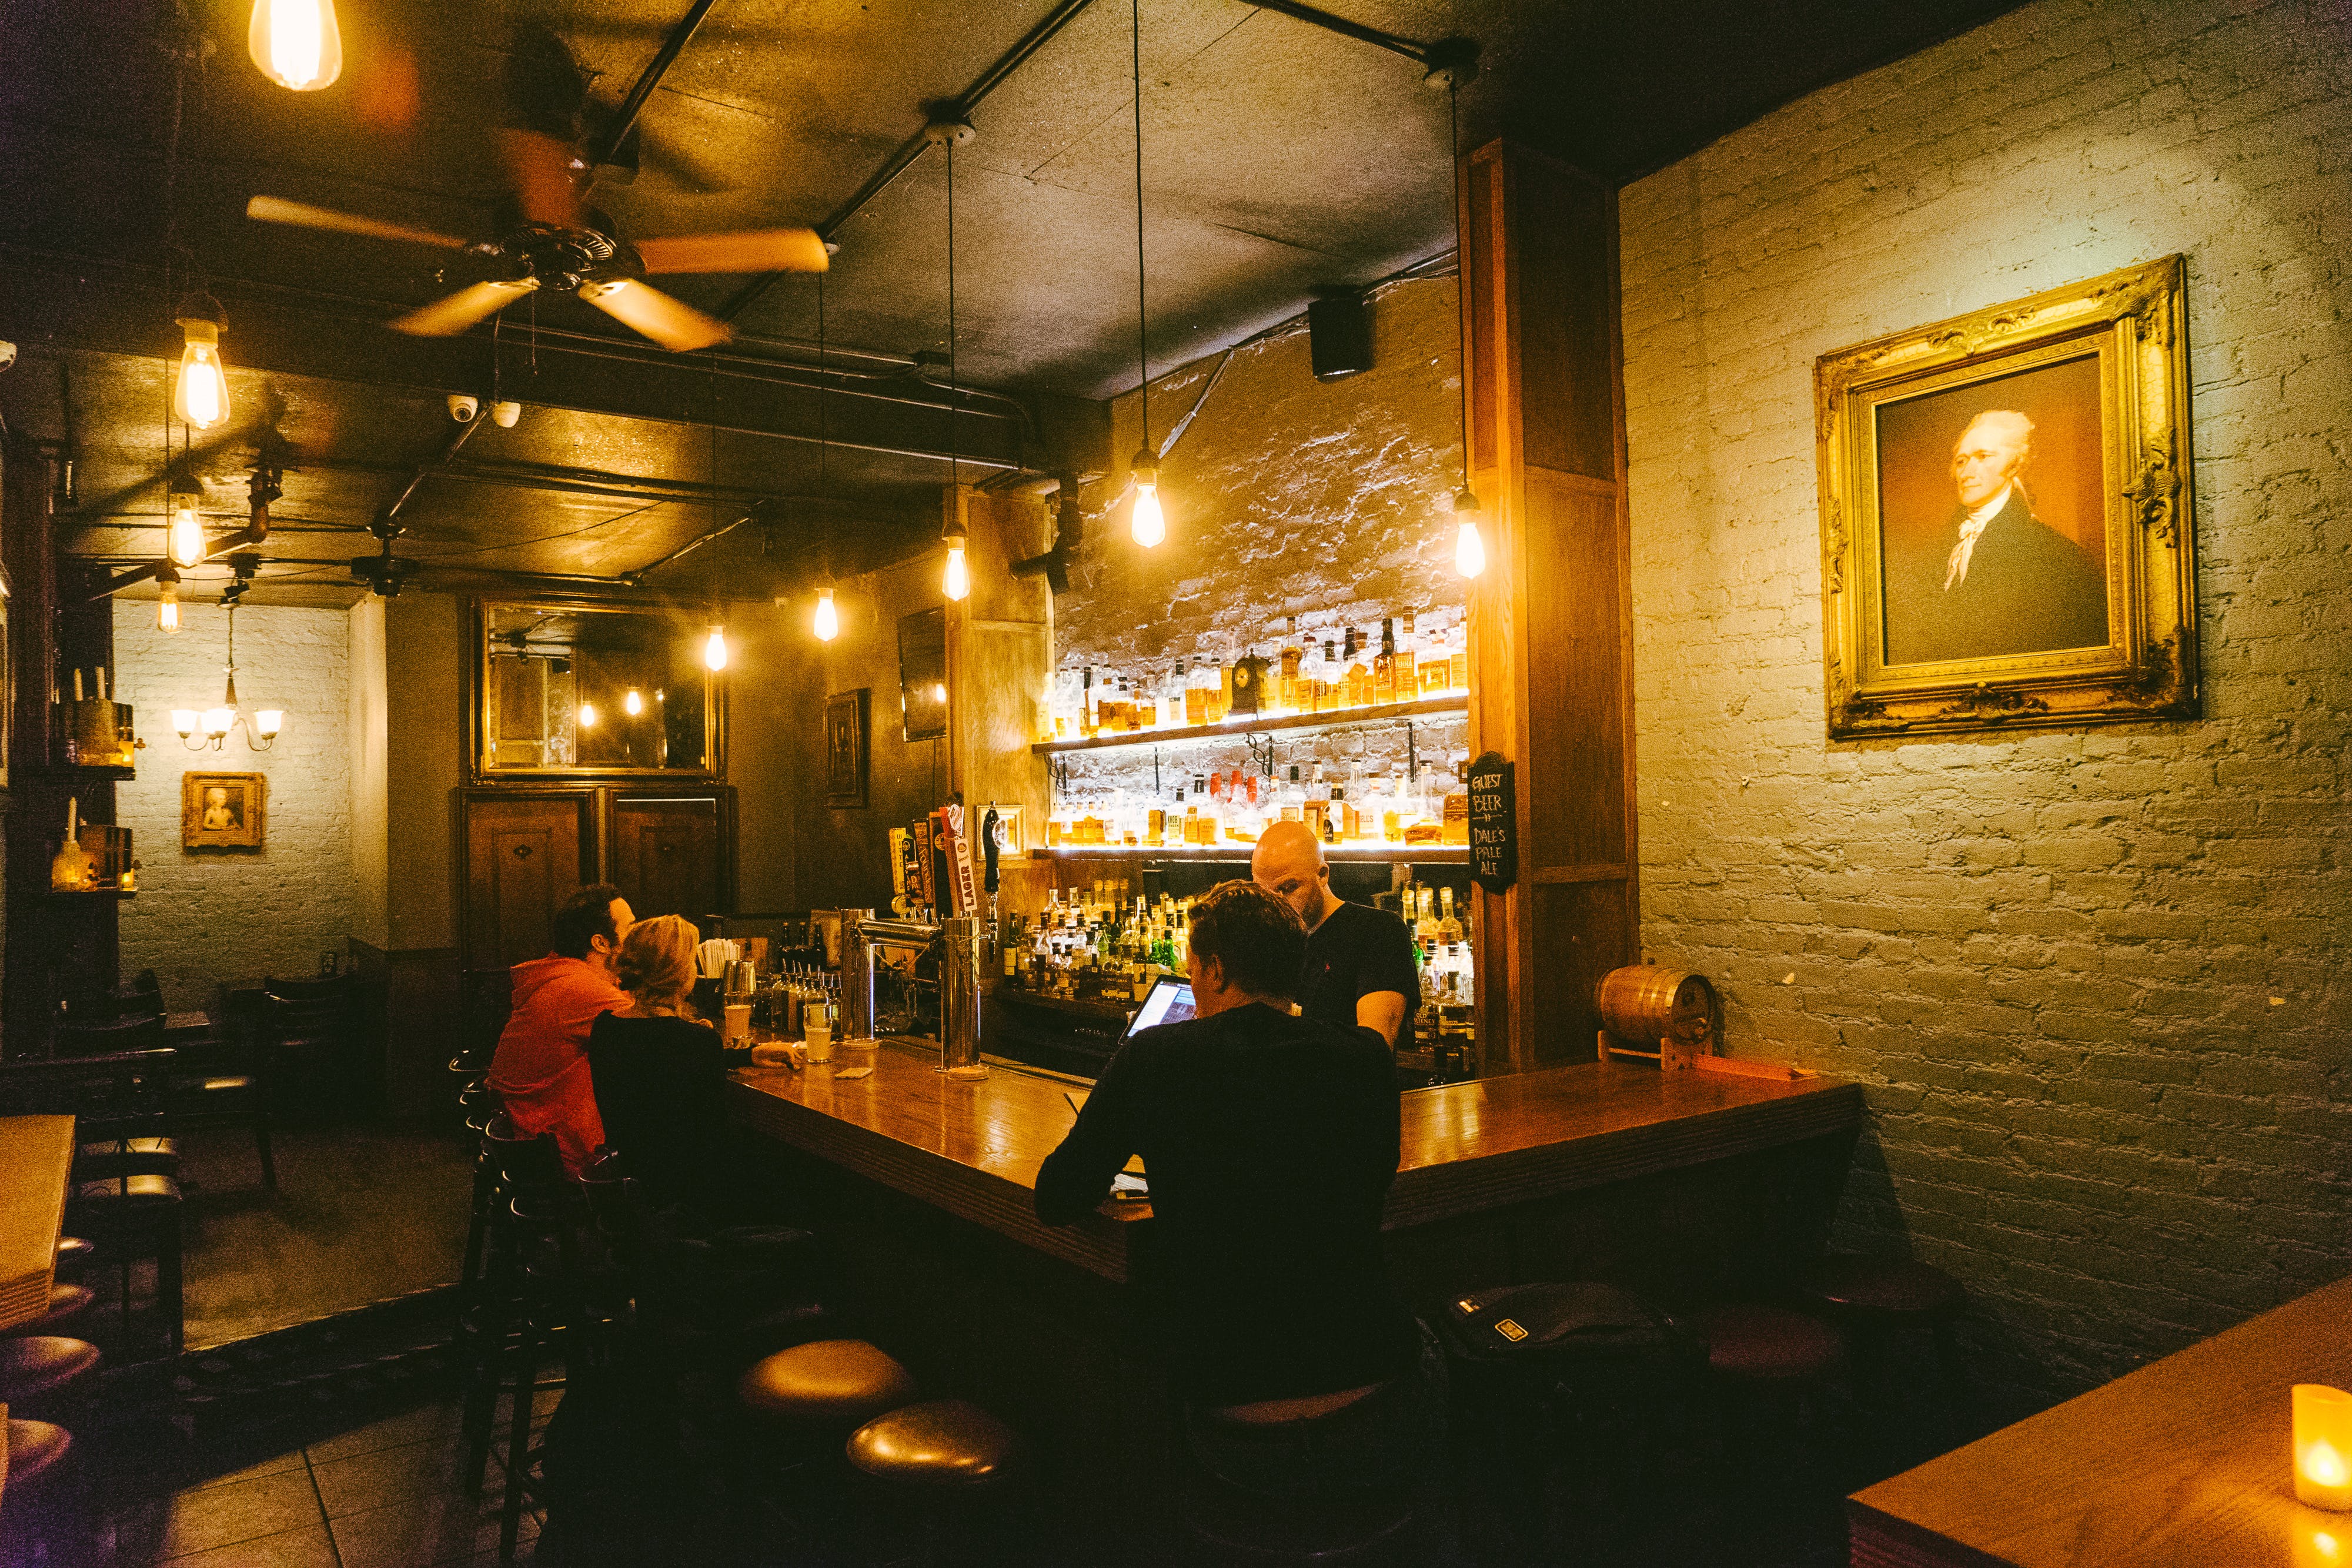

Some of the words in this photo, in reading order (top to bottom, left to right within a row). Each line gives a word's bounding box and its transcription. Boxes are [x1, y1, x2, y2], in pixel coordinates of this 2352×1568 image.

[1471, 773, 1504, 791] GUEST
[1472, 794, 1502, 813] BEER
[1168, 815, 1178, 824] KNOB
[1474, 826, 1505, 845] DALE'S
[1475, 847, 1502, 860] PALE
[1481, 861, 1497, 875] ALE
[960, 865, 974, 907] LAGER
